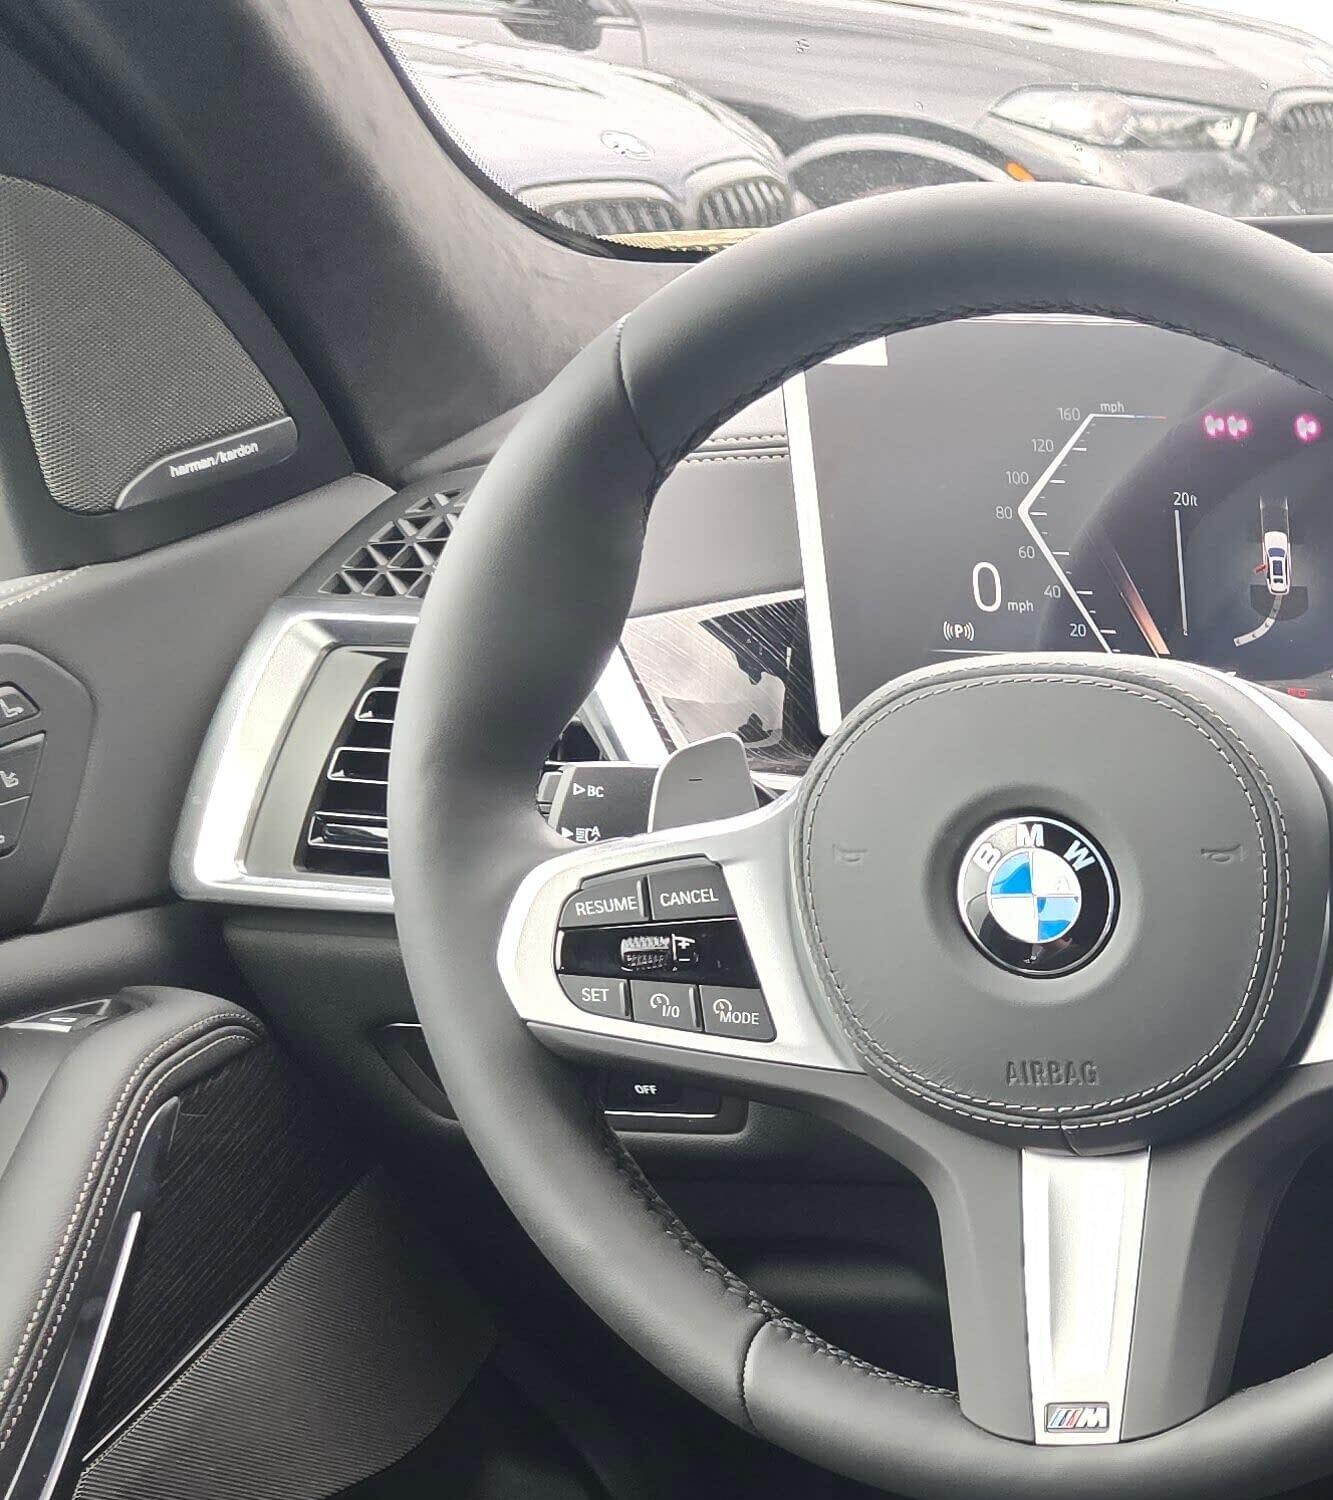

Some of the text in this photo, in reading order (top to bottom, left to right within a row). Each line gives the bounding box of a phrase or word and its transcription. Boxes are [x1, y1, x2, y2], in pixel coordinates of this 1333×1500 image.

[1058, 407, 1080, 421] 160
[1100, 402, 1124, 413] mph
[1032, 439, 1054, 452] 120
[169, 442, 259, 478] harman/kardon
[1006, 471, 1029, 485] 100
[1173, 492, 1198, 506] 20ft
[995, 506, 1013, 520] 80
[1018, 546, 1035, 559] 60
[972, 561, 1002, 612] 0
[1043, 585, 1061, 598] 40
[1007, 600, 1034, 613] mph
[1069, 623, 1087, 637] 20
[587, 785, 605, 798] BC
[972, 823, 1096, 873] BMW
[660, 887, 719, 908] CANCEL
[575, 896, 638, 917] RESUME
[581, 987, 610, 1002] SET
[719, 1011, 760, 1025] MODE
[1006, 1060, 1100, 1087] AIRBAG
[634, 1084, 658, 1095] OFF
